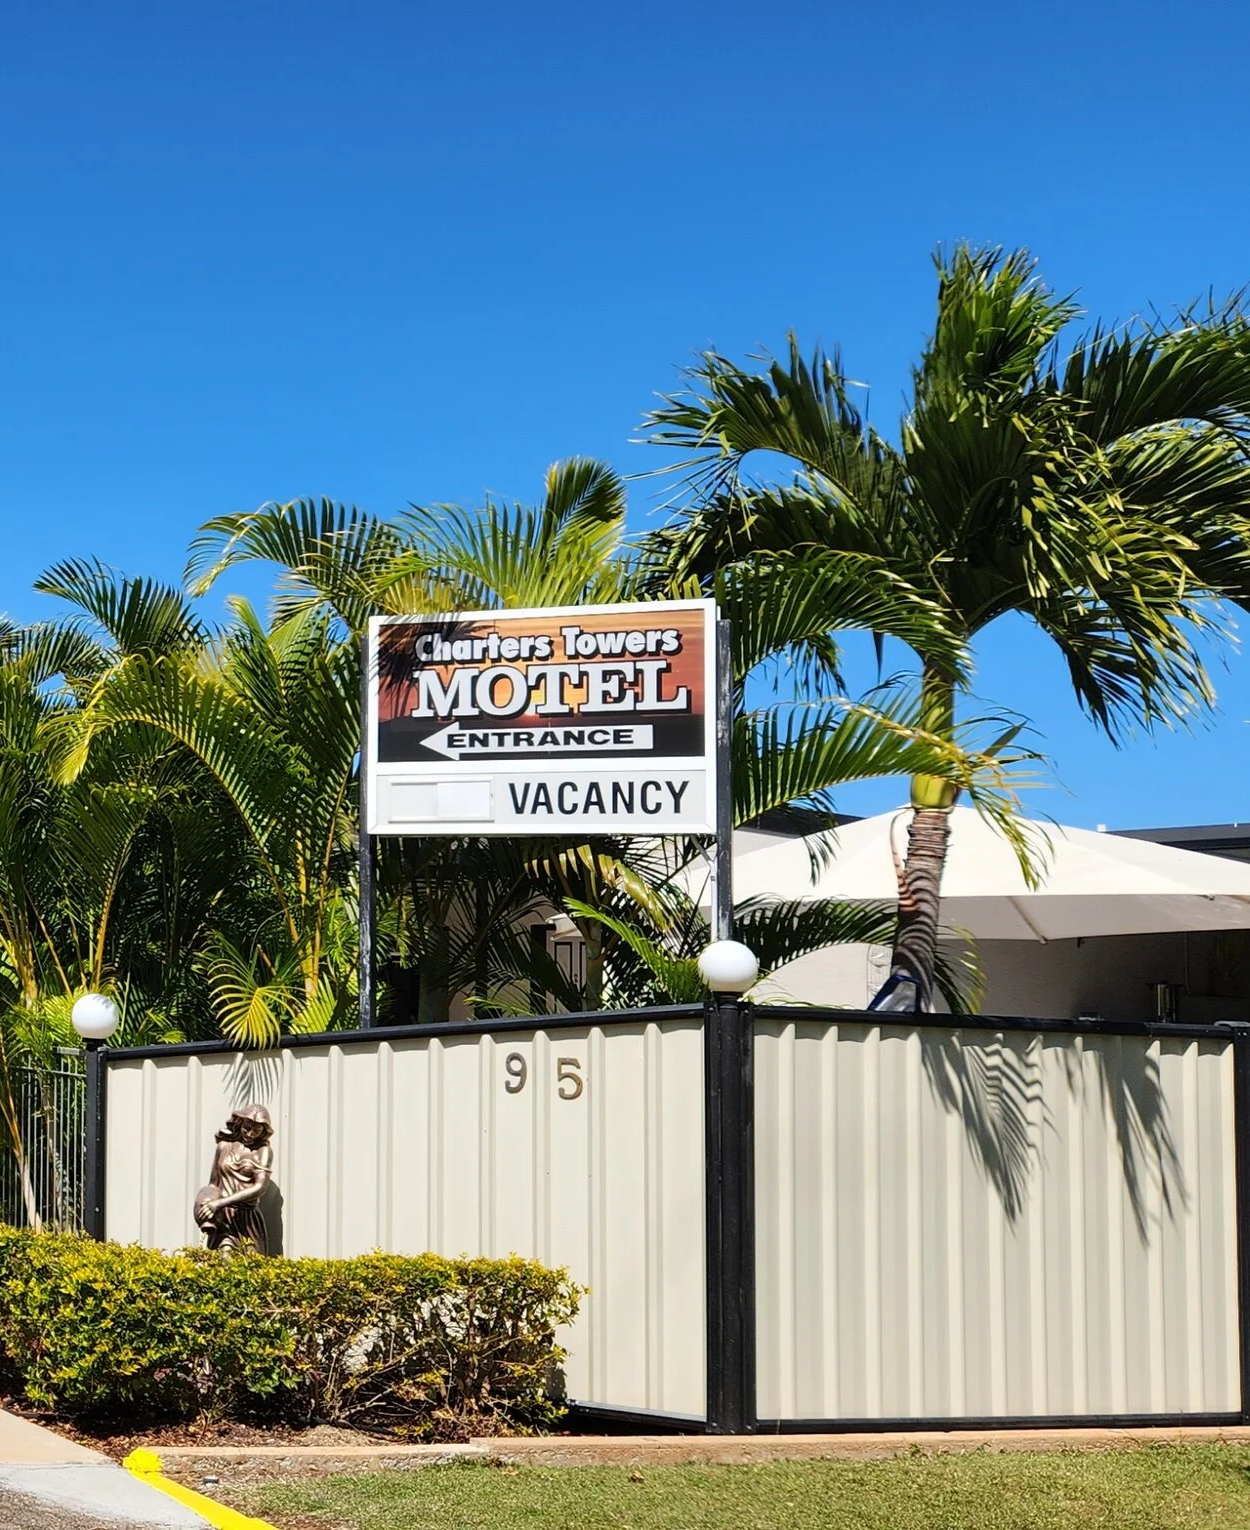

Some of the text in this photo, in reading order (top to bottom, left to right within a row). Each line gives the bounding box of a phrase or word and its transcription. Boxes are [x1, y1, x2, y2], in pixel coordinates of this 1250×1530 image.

[415, 626, 681, 663] Charters Towers
[411, 660, 688, 718] MOTEL
[447, 728, 634, 748] ENTRANCE
[508, 780, 690, 815] VACANCY
[505, 1052, 584, 1100] 95
